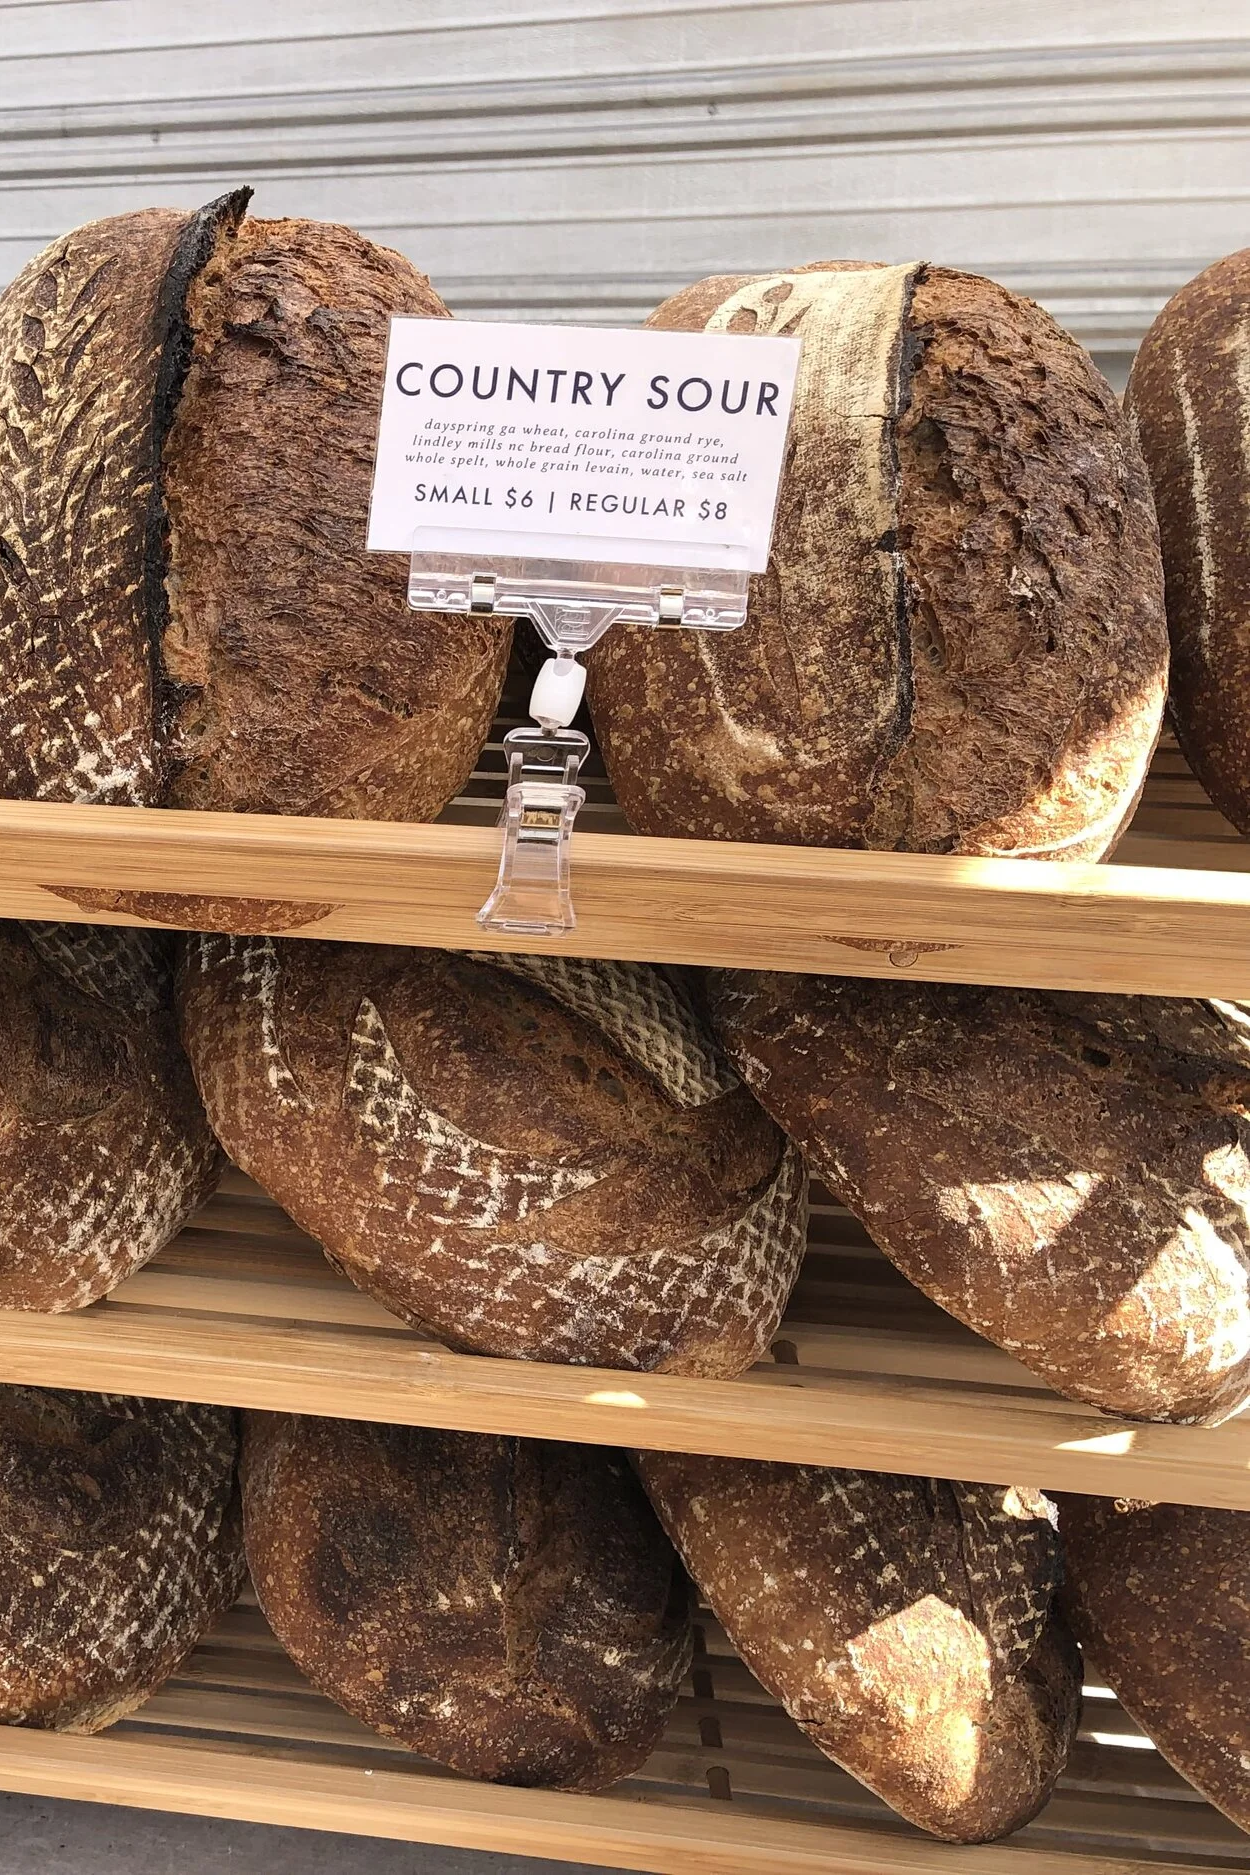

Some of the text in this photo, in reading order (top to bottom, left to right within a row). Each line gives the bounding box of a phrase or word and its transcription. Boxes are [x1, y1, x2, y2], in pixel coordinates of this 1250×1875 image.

[396, 362, 779, 417] COUNTRY SOUR
[424, 418, 724, 448] dayspring ga wheat, carolina ground rye,
[413, 435, 739, 465] lindley mills nc bread flour, carolina ground
[405, 452, 748, 482] whole spelt, whole grain levain, water, sea salt
[414, 483, 493, 506] SMALL
[505, 487, 534, 509] $6
[570, 492, 686, 518] REGULAR
[698, 498, 728, 521] $8
